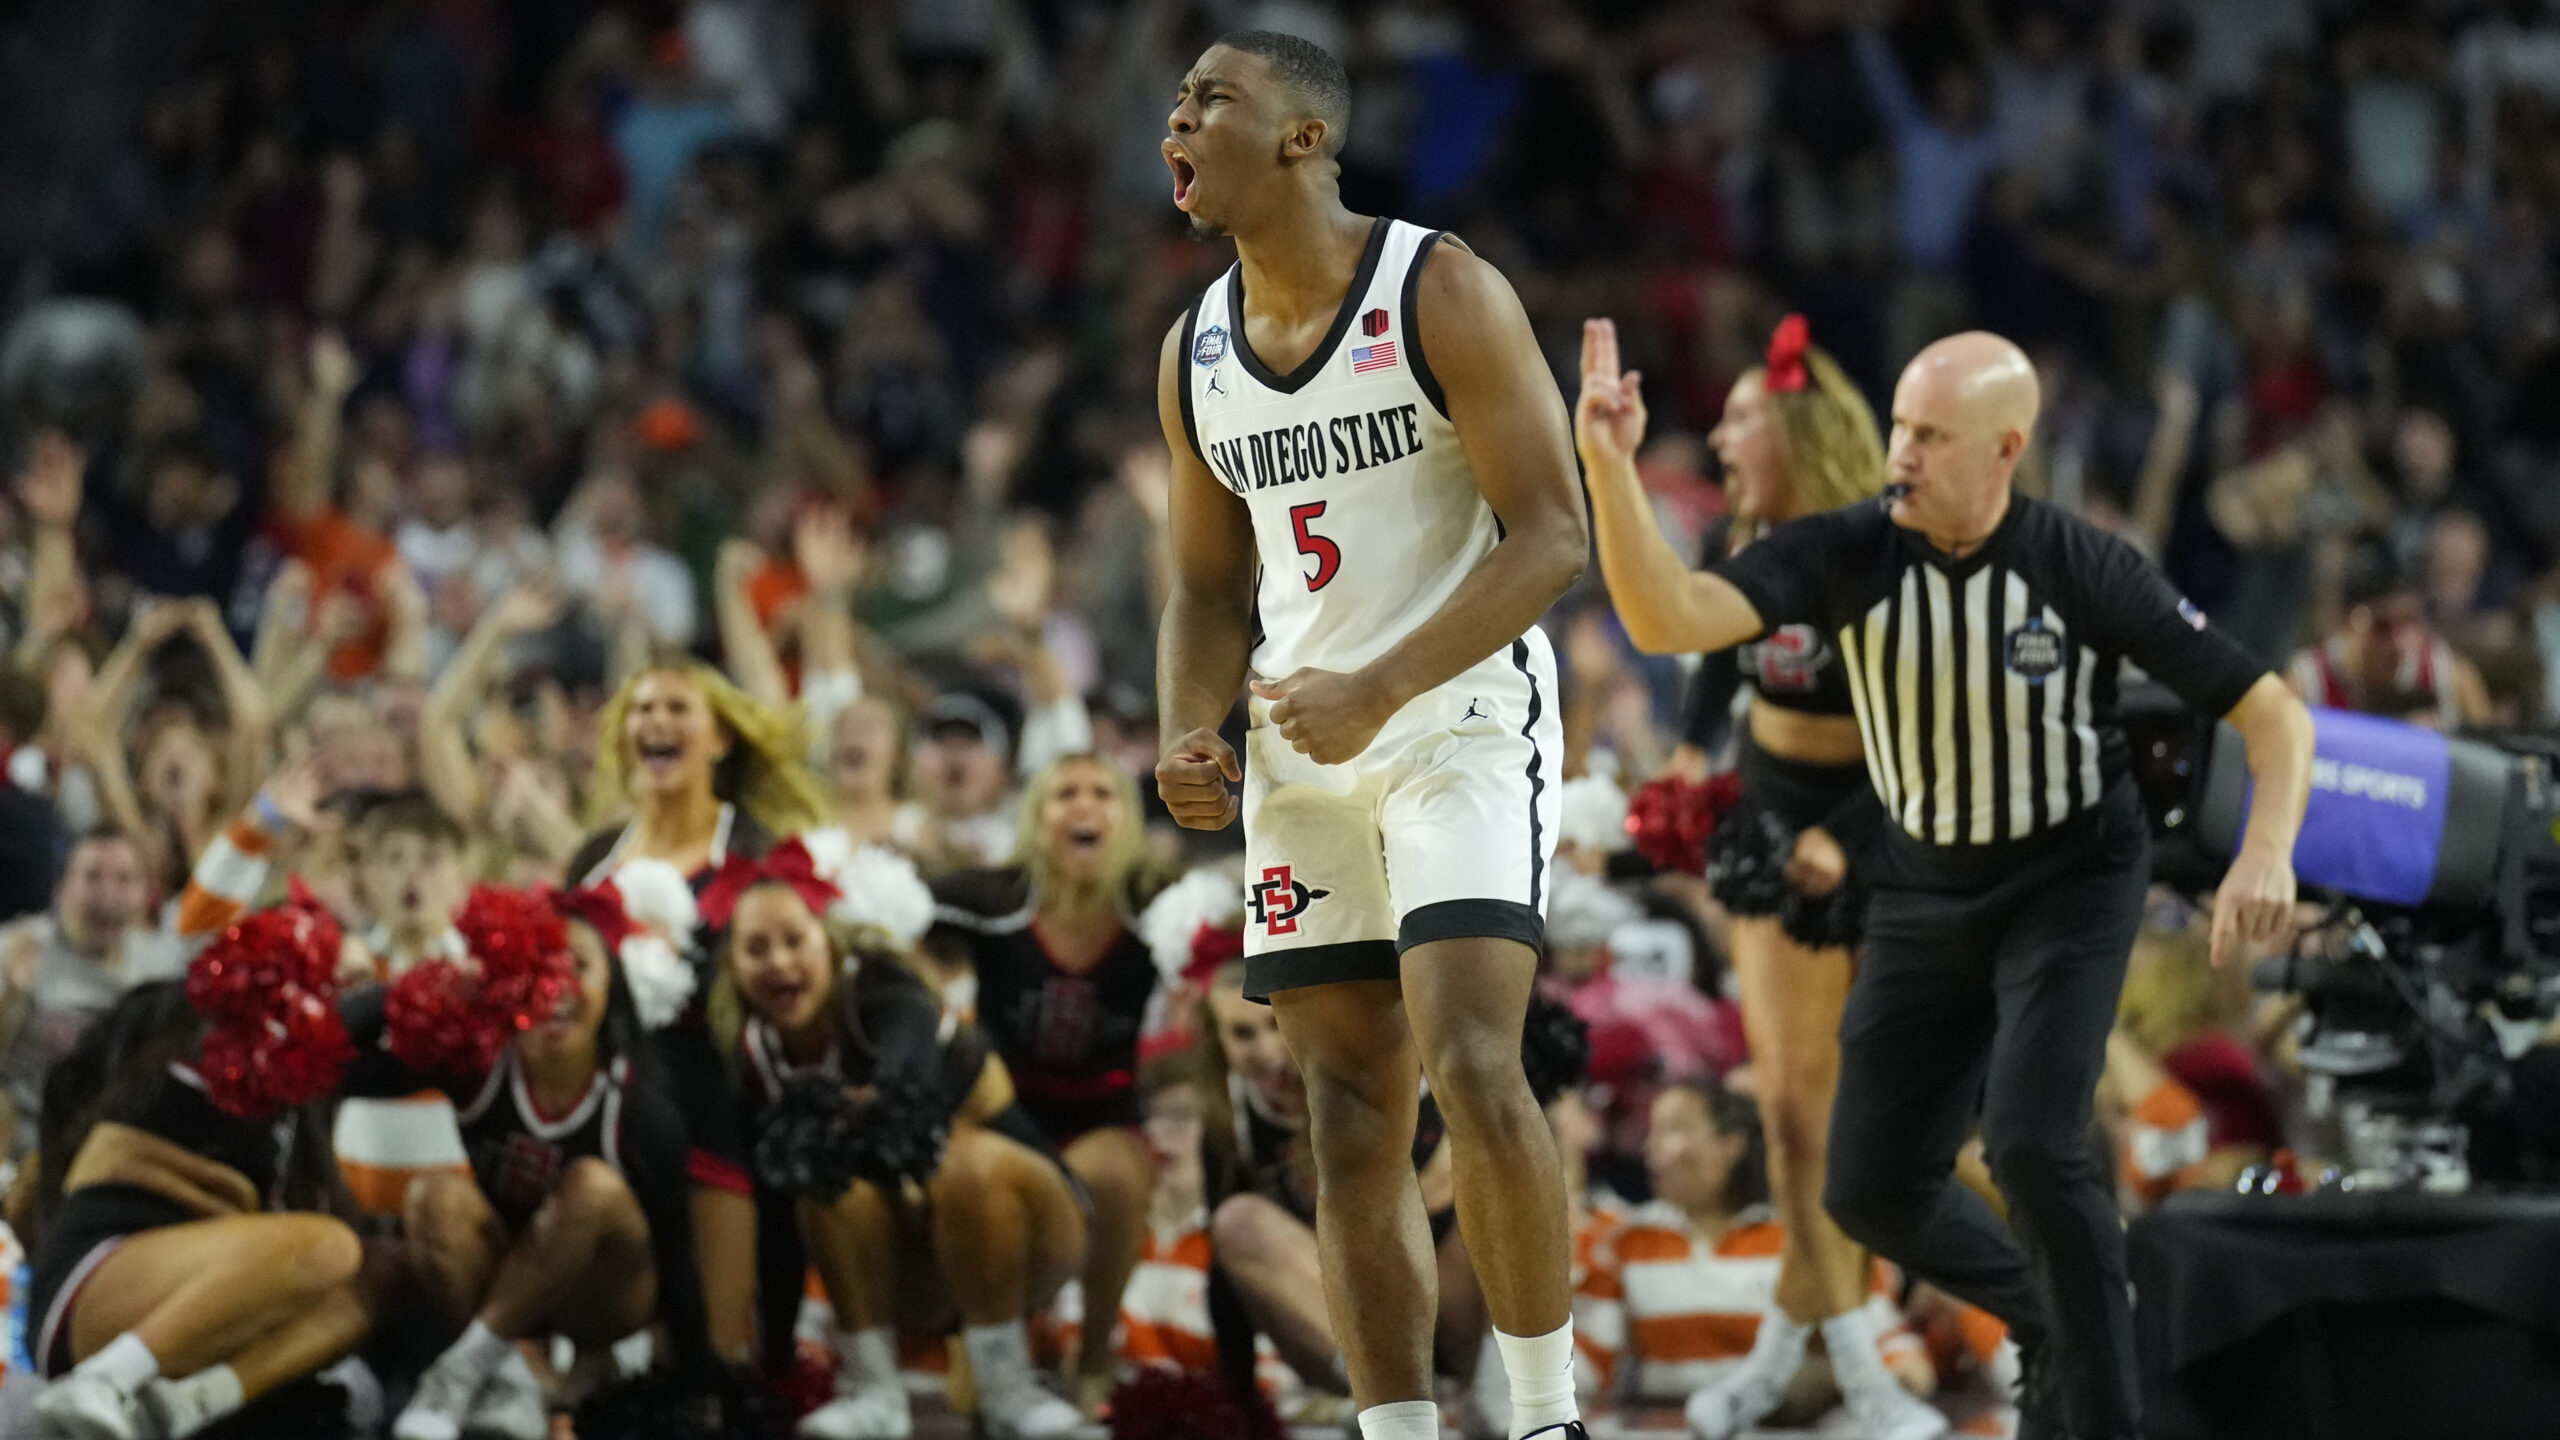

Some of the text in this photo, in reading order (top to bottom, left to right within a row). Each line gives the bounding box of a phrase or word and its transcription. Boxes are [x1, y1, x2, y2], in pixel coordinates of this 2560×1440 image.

[1201, 334, 1224, 347] FINAL
[1201, 344, 1223, 356] FOUR
[1210, 403, 1424, 494] SAN DIEGO STATE
[1289, 500, 1341, 593] 5
[2312, 757, 2428, 810] BS SPORTS
